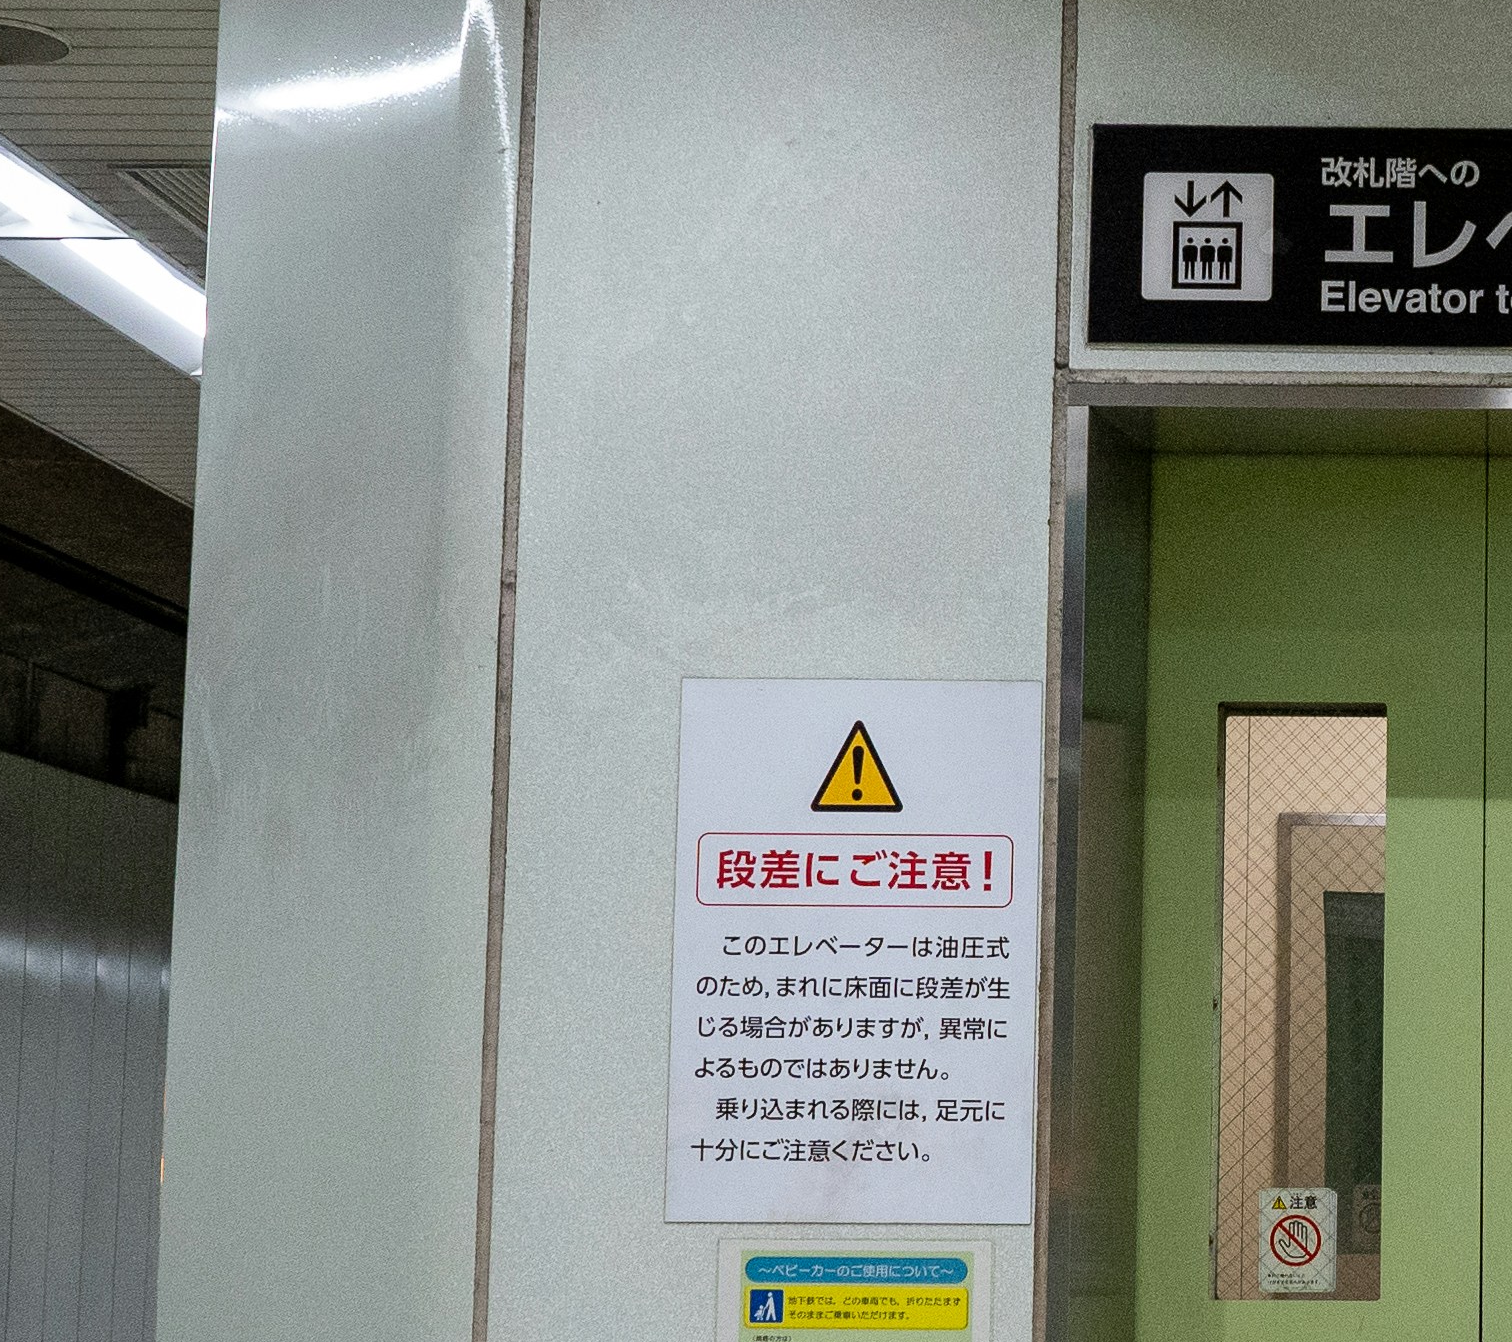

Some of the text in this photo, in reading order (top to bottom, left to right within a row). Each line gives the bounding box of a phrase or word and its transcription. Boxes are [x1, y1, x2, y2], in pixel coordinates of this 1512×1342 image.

[1321, 157, 1481, 189] 改札階への
[1320, 280, 1486, 315] Elevator
[717, 849, 995, 891] 段差にご注意！
[722, 936, 1011, 959] このエレベーターは油圧式
[694, 1057, 950, 1081] よるものではありません。
[691, 1138, 932, 1163] 十分にご注意ください。
[1290, 1194, 1318, 1209] 注意
